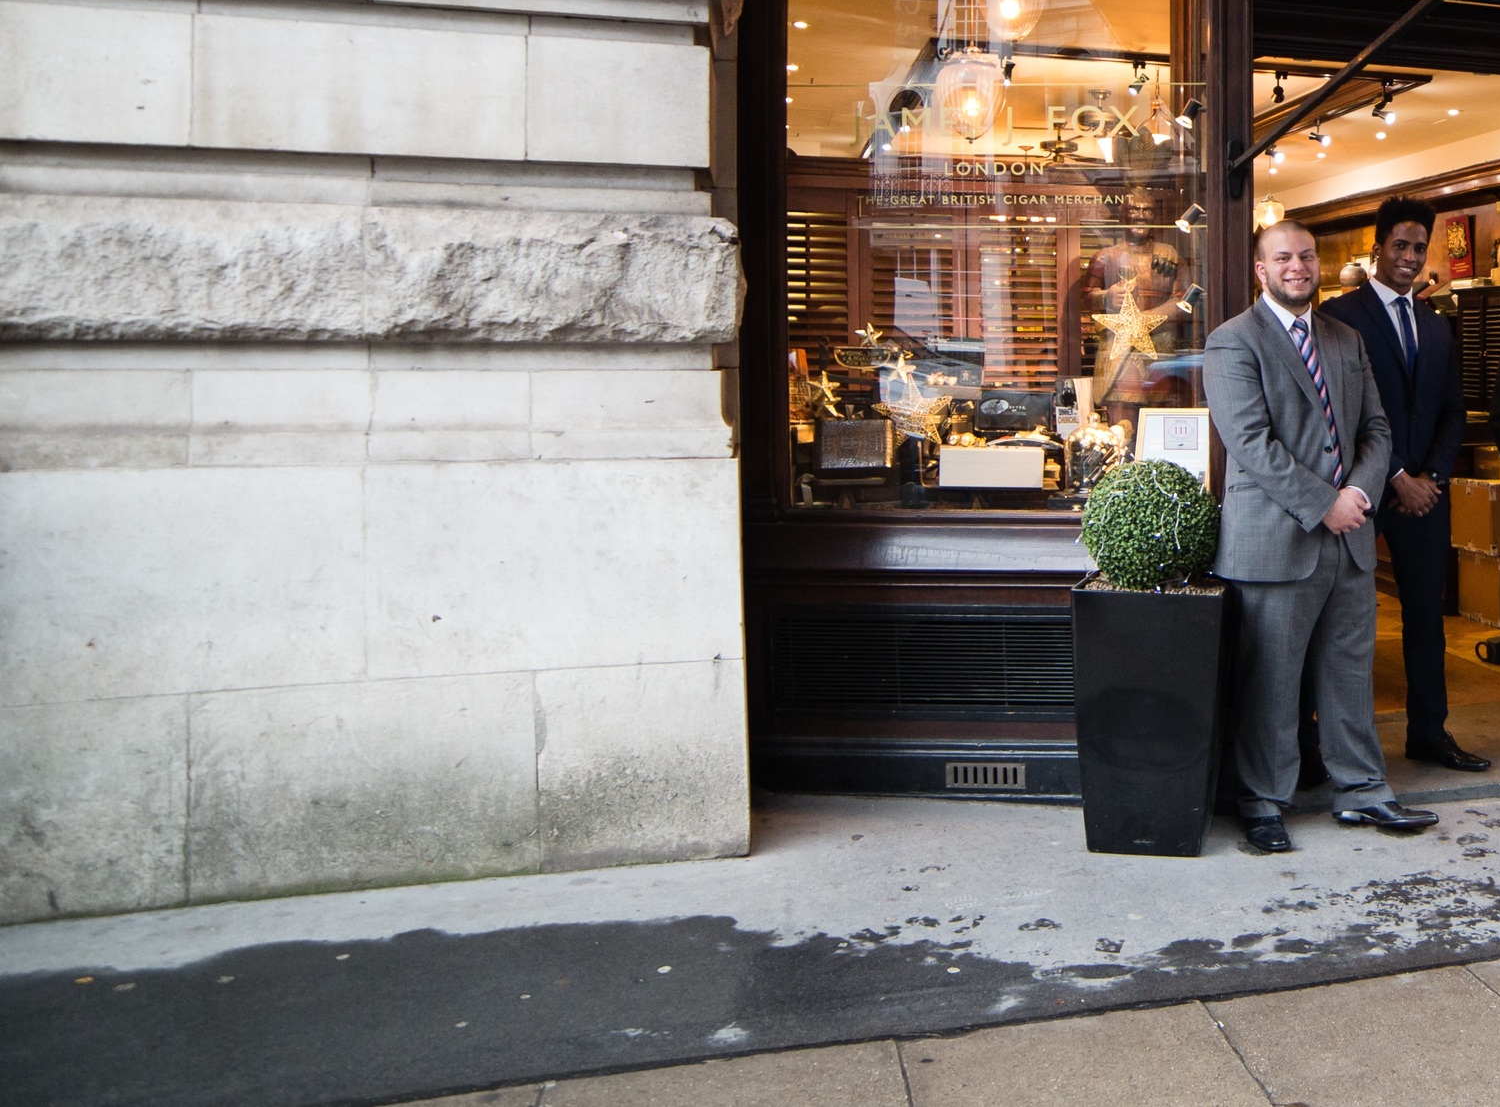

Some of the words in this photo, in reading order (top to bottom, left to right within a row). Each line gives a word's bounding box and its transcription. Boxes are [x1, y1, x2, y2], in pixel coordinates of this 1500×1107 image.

[851, 106, 972, 147] JAME
[1047, 105, 1141, 138] FOX
[944, 161, 1045, 177] LONDON
[857, 195, 884, 206] THE
[890, 195, 935, 206] GREAT
[941, 195, 997, 206] BRITISH
[1003, 195, 1048, 206] CIGAR
[1054, 195, 1134, 206] MERCHANT
